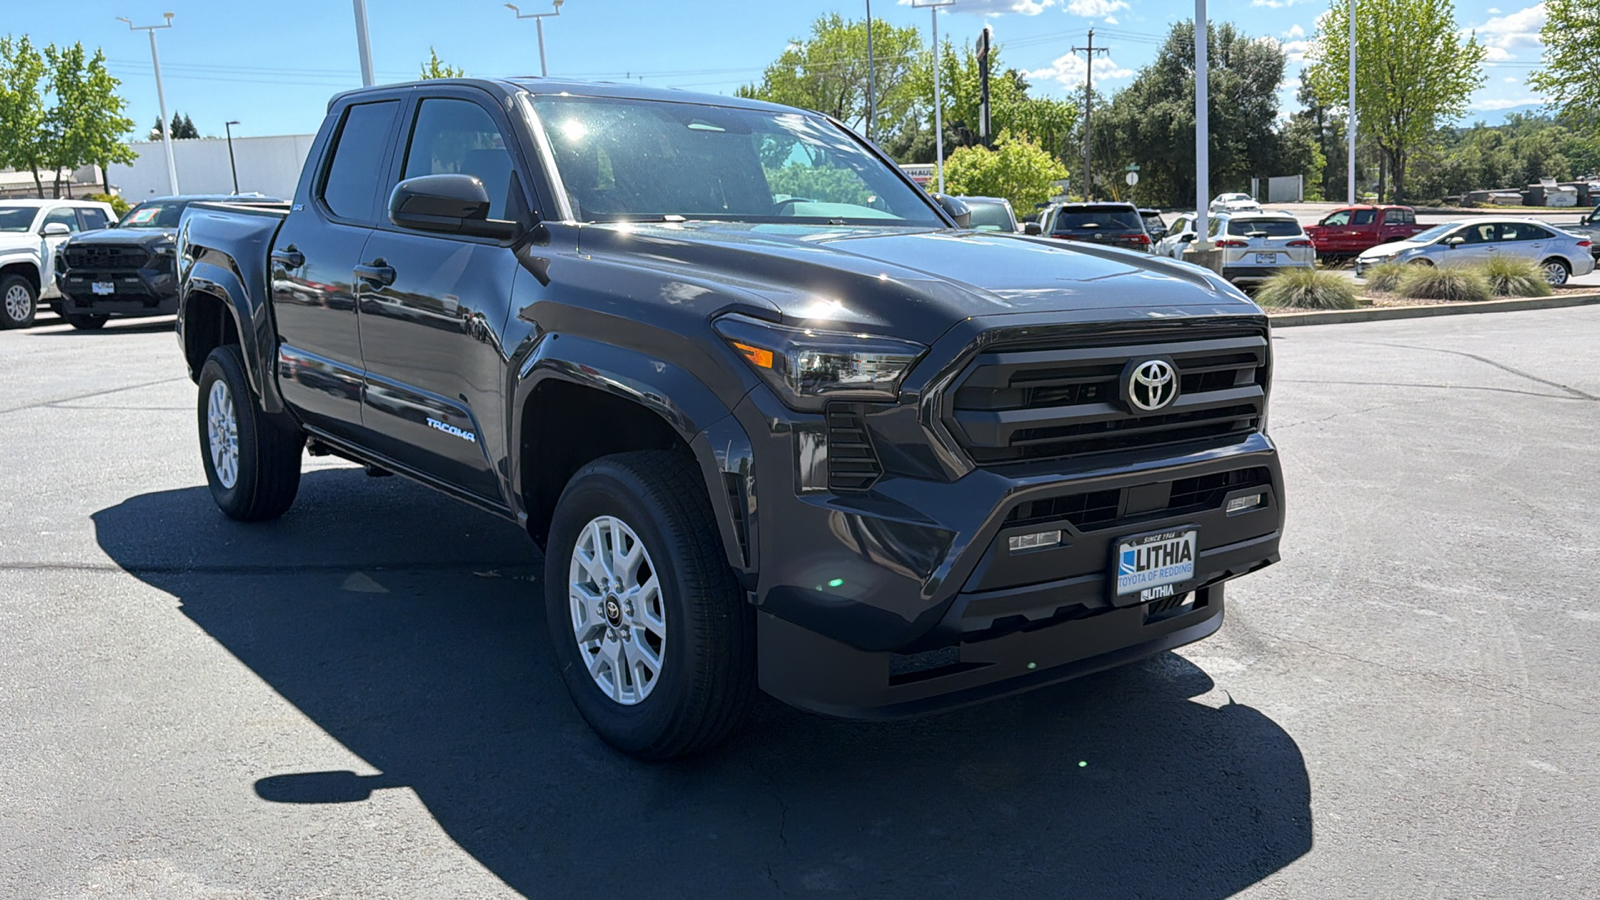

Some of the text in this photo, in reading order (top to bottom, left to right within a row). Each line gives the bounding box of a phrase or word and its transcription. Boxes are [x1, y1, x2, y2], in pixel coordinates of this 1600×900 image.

[426, 417, 476, 443] TACOMA
[1144, 534, 1162, 544] SINCE
[1136, 539, 1192, 572] LITHIA
[1118, 563, 1192, 588] TOYOTA OF REDDING
[1149, 584, 1174, 599] LITHIA
